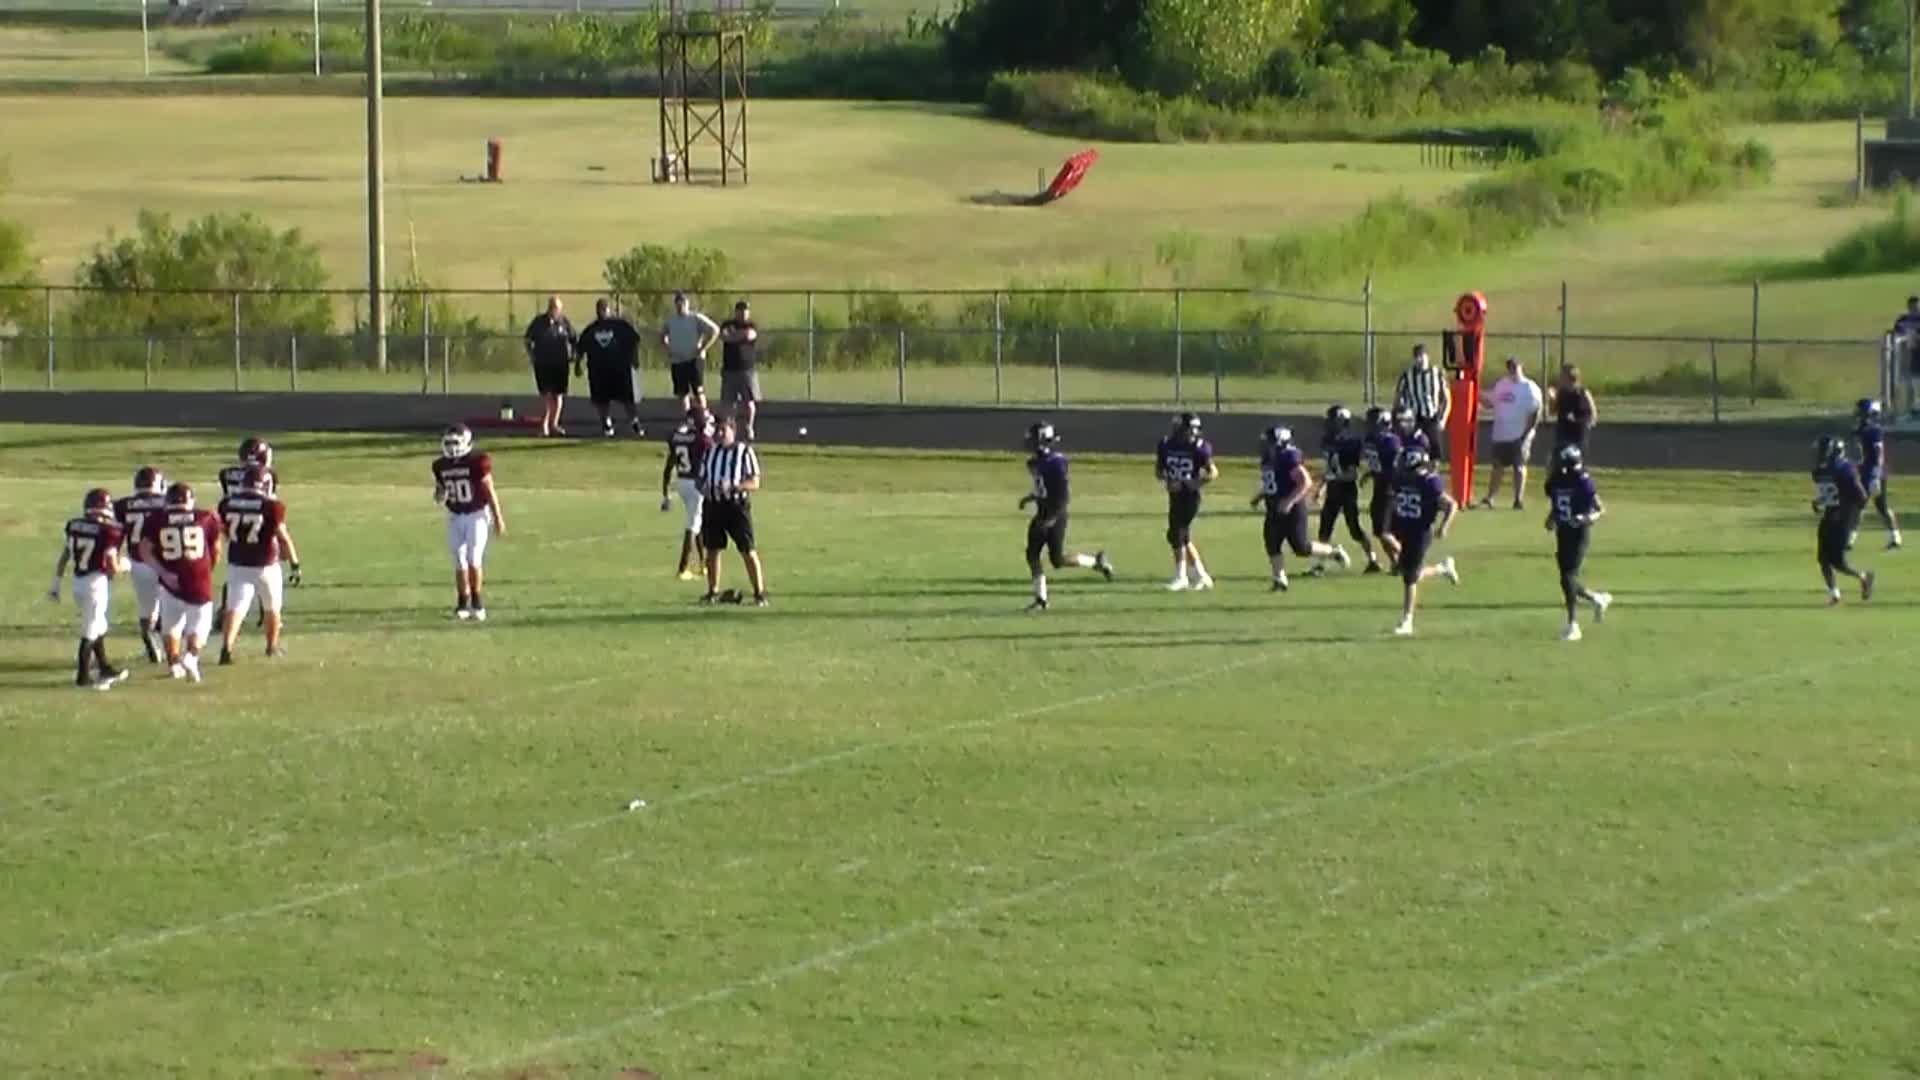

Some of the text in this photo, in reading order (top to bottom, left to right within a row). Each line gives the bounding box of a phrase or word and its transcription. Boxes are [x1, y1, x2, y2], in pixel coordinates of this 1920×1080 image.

[675, 447, 692, 474] 3
[1166, 456, 1193, 480] 52
[444, 480, 472, 503] 20
[1397, 492, 1422, 518] 25
[1557, 495, 1572, 521] 5
[225, 512, 264, 543] 77
[68, 535, 96, 570] 17
[159, 527, 204, 560] 99
